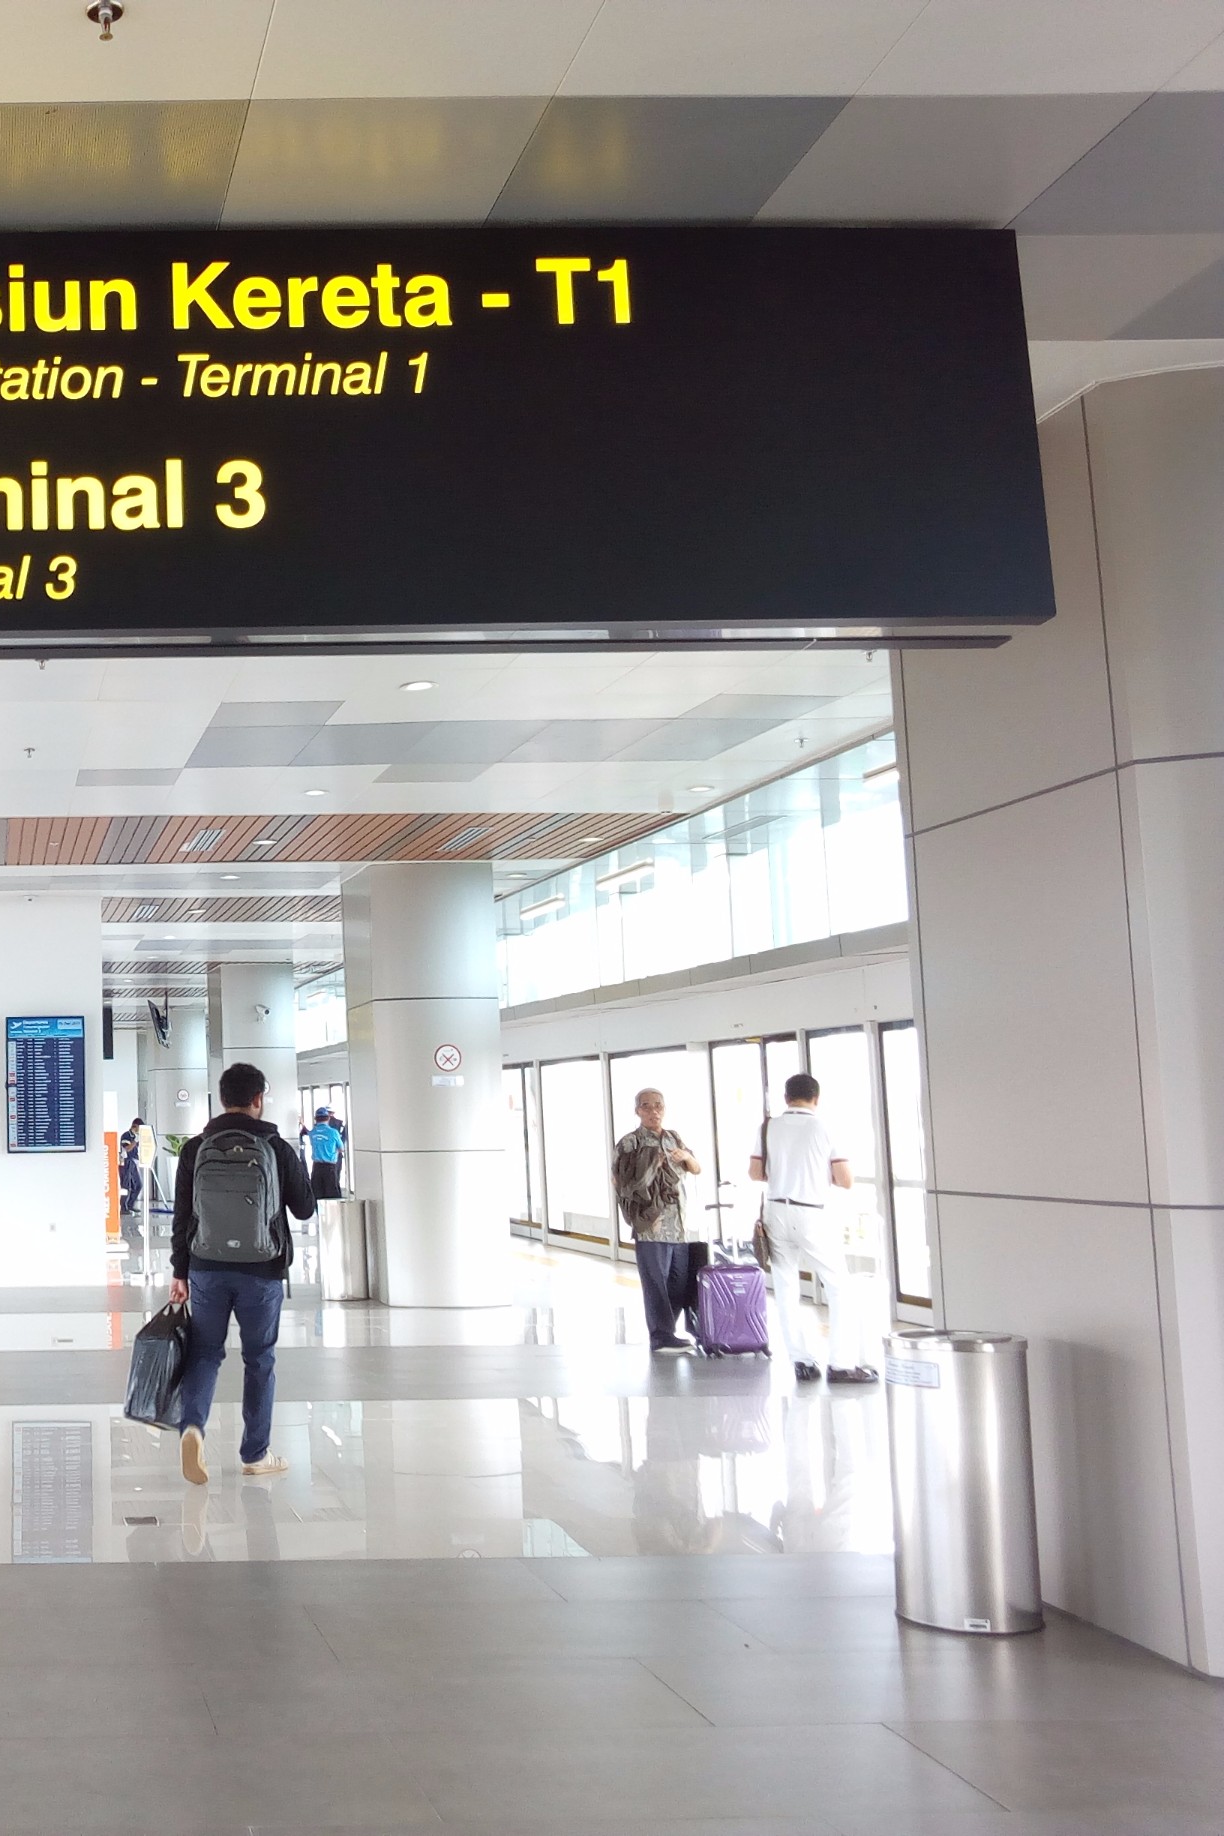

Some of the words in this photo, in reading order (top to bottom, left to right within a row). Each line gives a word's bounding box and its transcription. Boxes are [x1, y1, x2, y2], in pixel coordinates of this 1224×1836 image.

[171, 261, 453, 330] Kereta
[481, 292, 510, 307] -
[535, 257, 631, 325] T1
[140, 377, 159, 386] -
[177, 350, 389, 398] Terminal
[408, 351, 429, 394] 1
[215, 459, 267, 529] 3
[45, 554, 78, 601] 3
